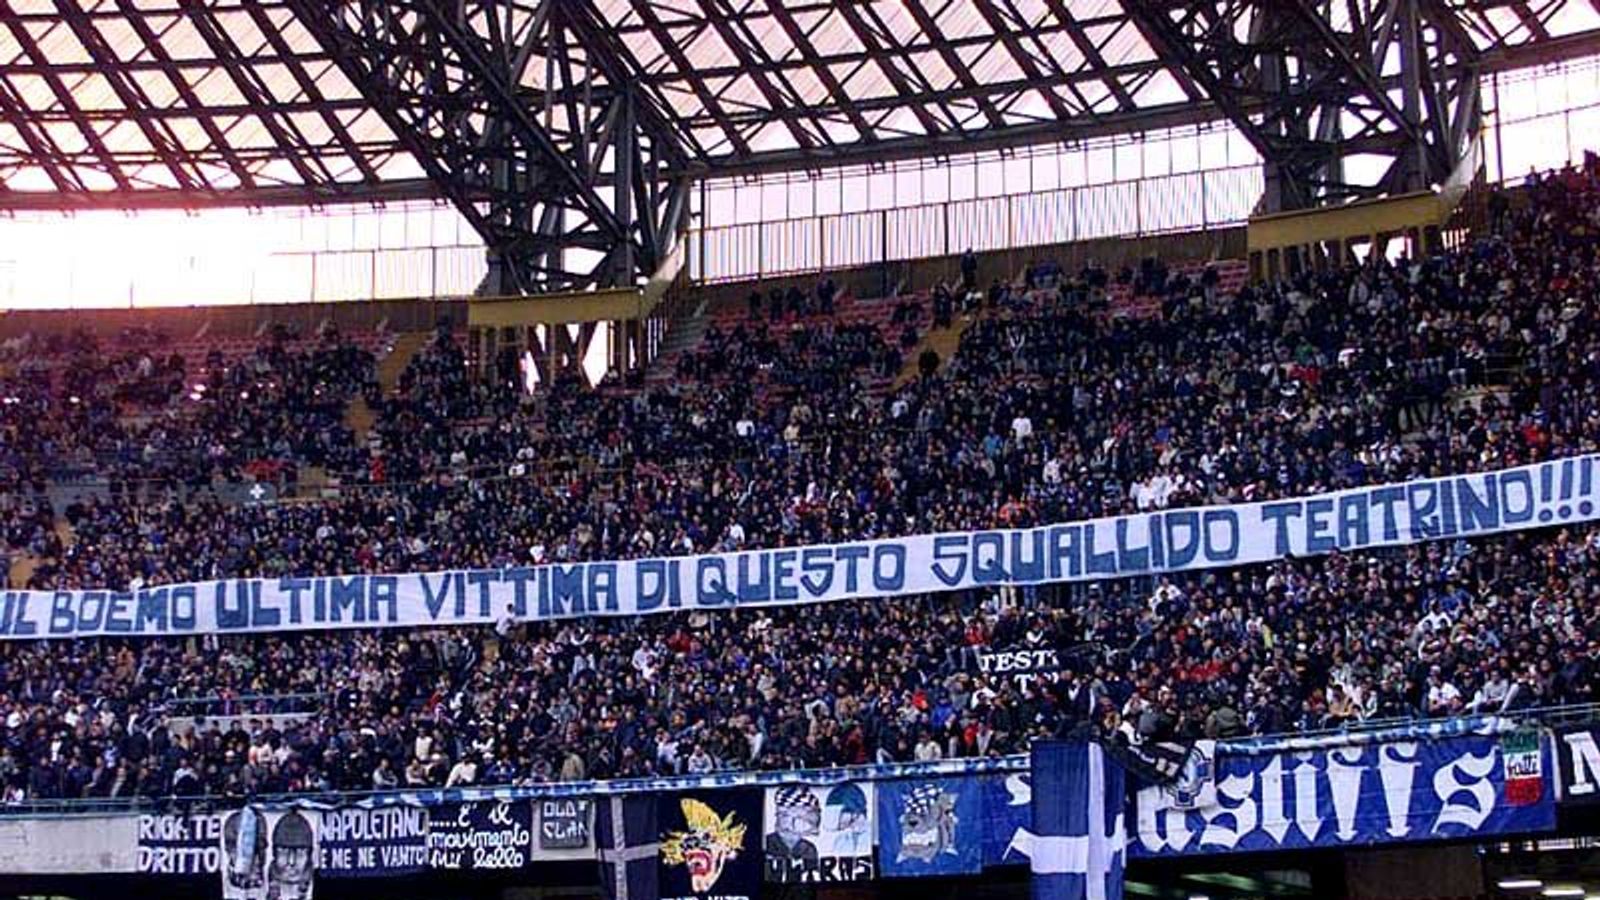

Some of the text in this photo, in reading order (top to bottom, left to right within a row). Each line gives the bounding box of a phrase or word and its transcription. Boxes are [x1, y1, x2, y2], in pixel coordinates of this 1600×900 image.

[49, 586, 196, 633] BOEMO
[215, 577, 398, 628] ULTIMA
[419, 564, 618, 619] VITTIMA
[636, 560, 681, 610] DI
[698, 543, 906, 605] QUESTO
[931, 509, 1240, 585] SQUALLIDO
[1261, 456, 1593, 557] TEATRINO!!!
[137, 846, 220, 873] DRITTO
